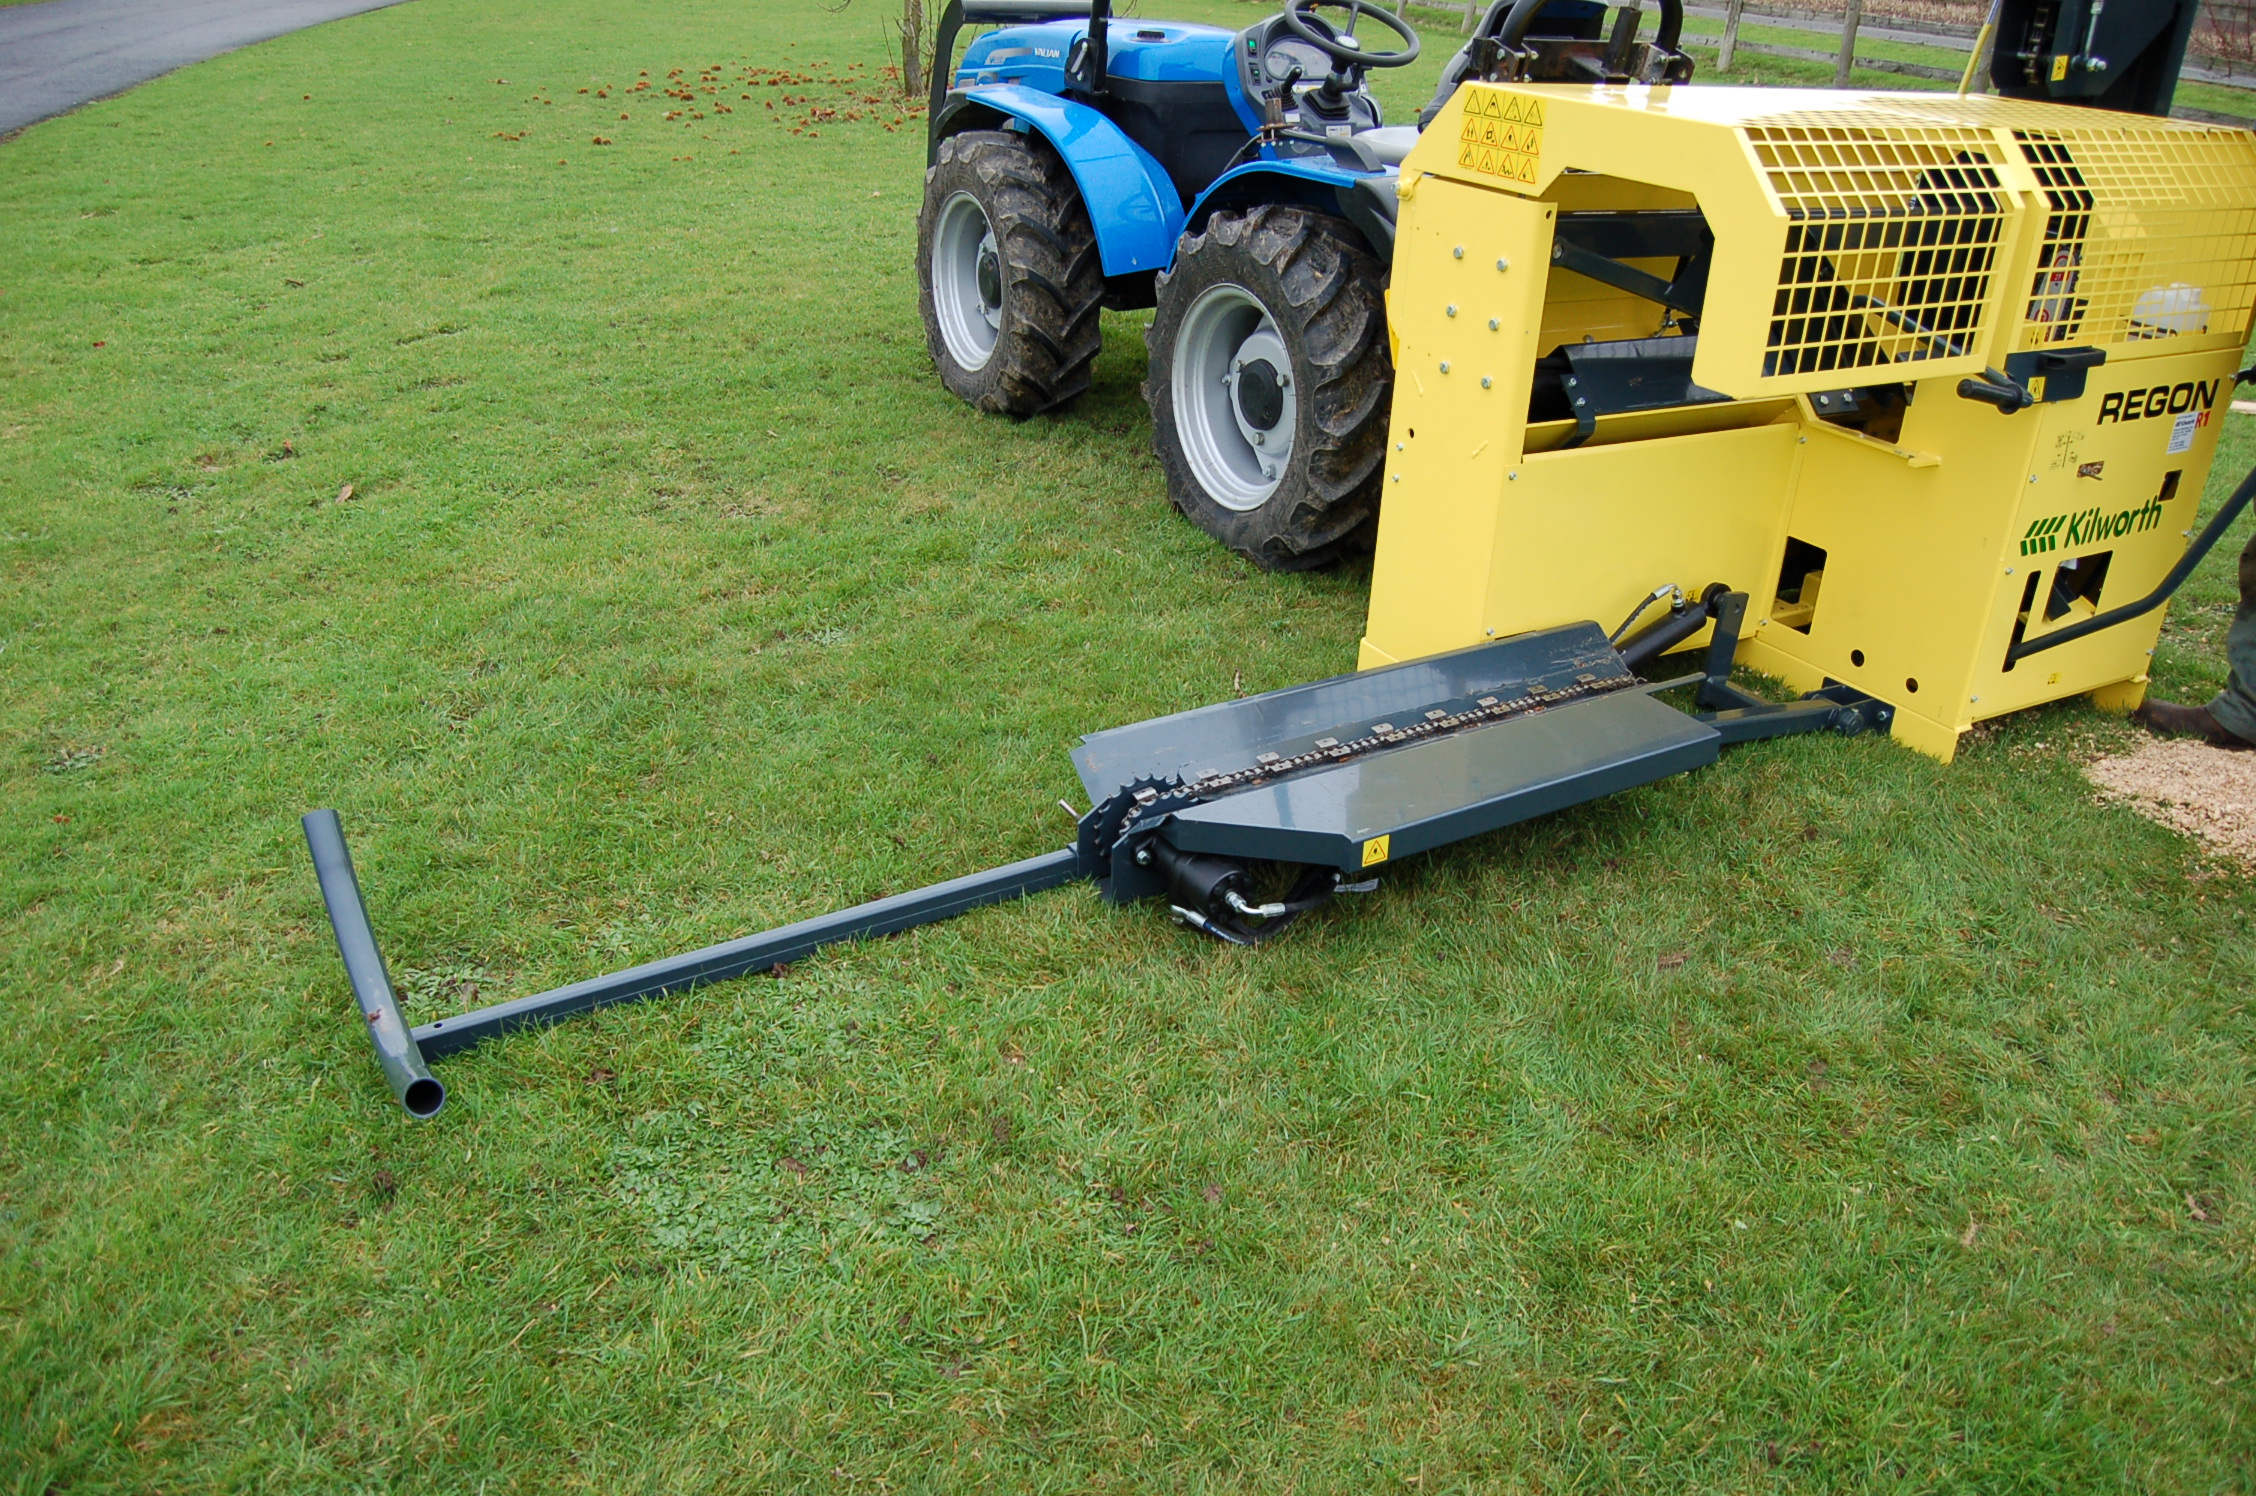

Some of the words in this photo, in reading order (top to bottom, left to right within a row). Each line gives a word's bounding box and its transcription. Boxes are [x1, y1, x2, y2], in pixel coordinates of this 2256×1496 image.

[2097, 378, 2220, 425] REGON
[2194, 411, 2212, 429] R1
[2065, 496, 2163, 548] Kilworth
